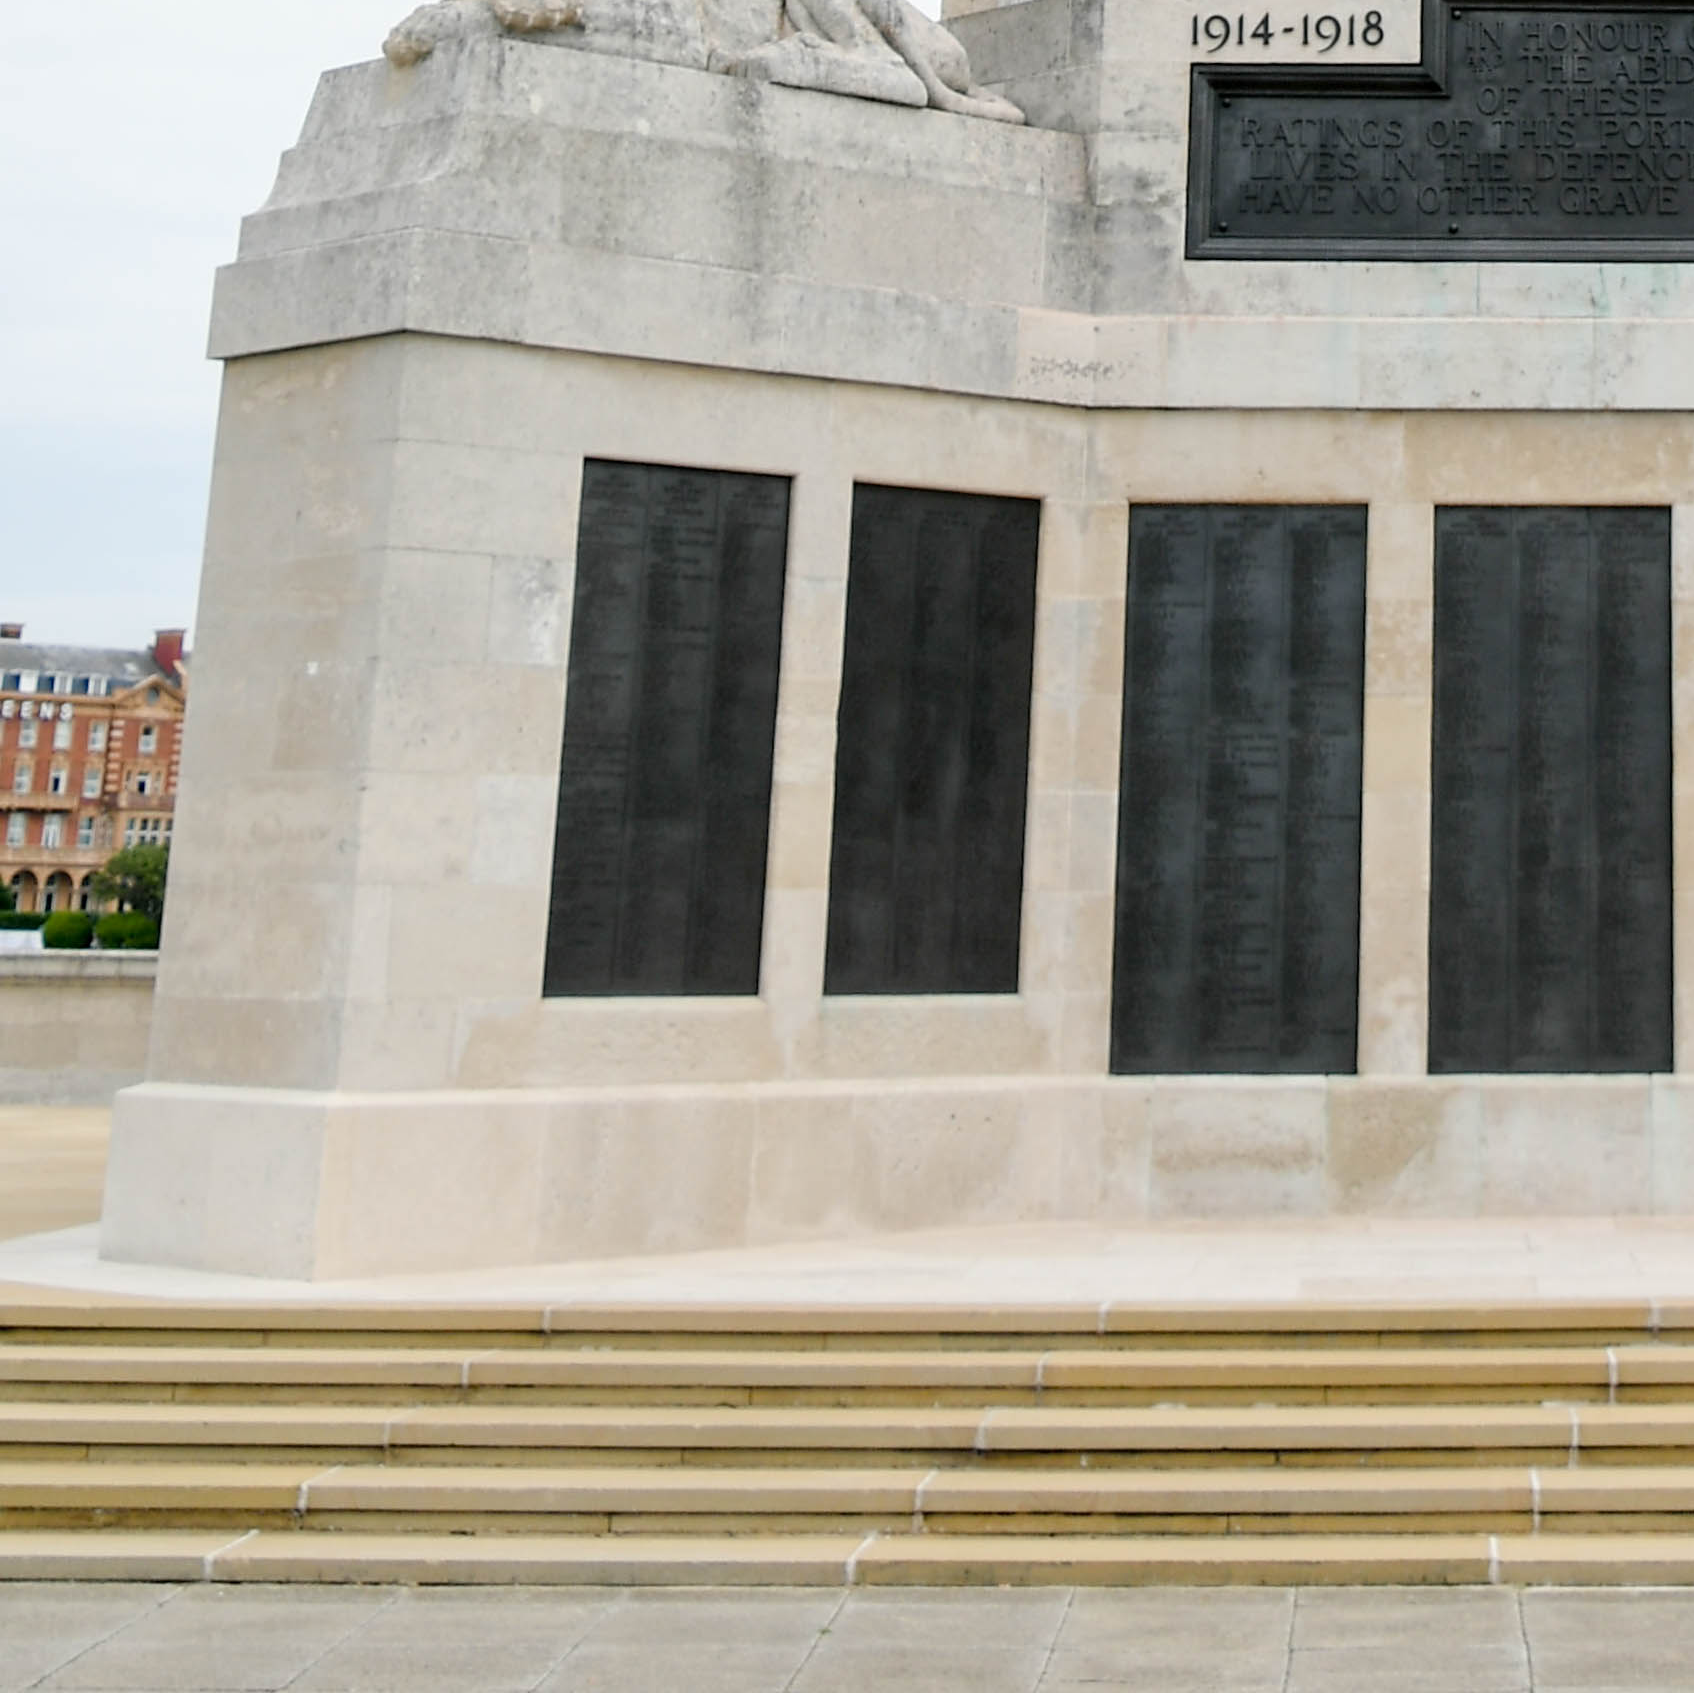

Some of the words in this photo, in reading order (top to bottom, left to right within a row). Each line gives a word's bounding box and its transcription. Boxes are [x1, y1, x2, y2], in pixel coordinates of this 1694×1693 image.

[1192, 10, 1384, 53] 1914-1918
[1466, 22, 1503, 51] IN
[1520, 23, 1670, 53] HONOUR
[1519, 55, 1593, 84] THE
[1476, 87, 1521, 115] OF
[1539, 87, 1666, 116] THESE
[1240, 118, 1404, 148] RATINGS
[1426, 119, 1474, 148] OF
[1491, 119, 1576, 149] THIS
[1600, 119, 1694, 149] PORT
[1250, 151, 1359, 181] LIVES
[1382, 151, 1417, 181] IN
[1436, 153, 1511, 182] THE
[1239, 184, 1334, 214] HAVE
[1352, 185, 1400, 214] NO
[1417, 185, 1538, 215] OTHER
[1559, 185, 1680, 215] GRAVE
